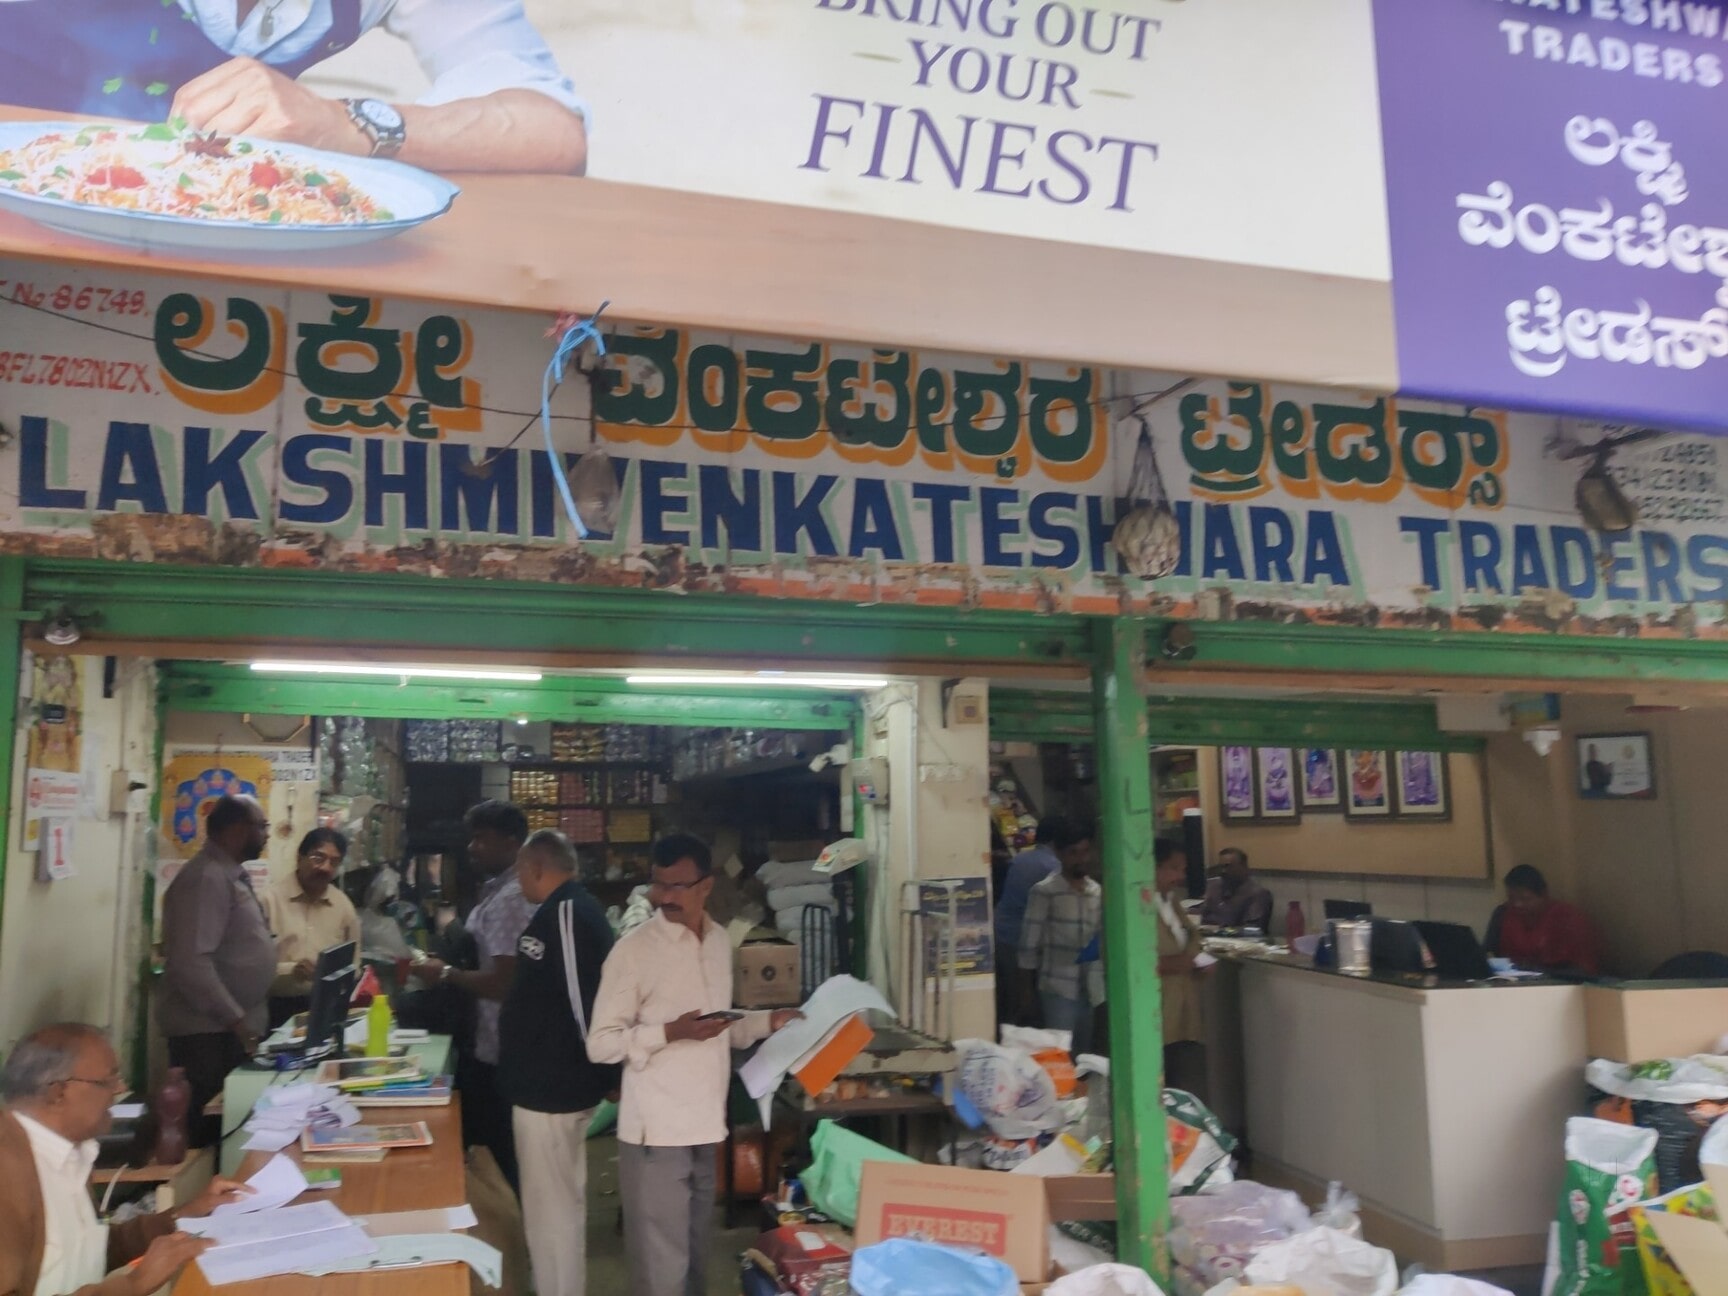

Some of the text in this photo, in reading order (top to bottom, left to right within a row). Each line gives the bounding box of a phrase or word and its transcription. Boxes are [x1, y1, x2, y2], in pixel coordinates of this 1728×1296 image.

[814, 0, 1162, 61] ING OUT
[1499, 19, 1724, 88] TRADERS
[1510, 0, 1728, 41] ESHW
[906, 38, 1084, 110] YOUR
[797, 92, 1160, 213] FINEST
[1399, 515, 1728, 603] TRADERS
[887, 1212, 1000, 1246] EVEREST
